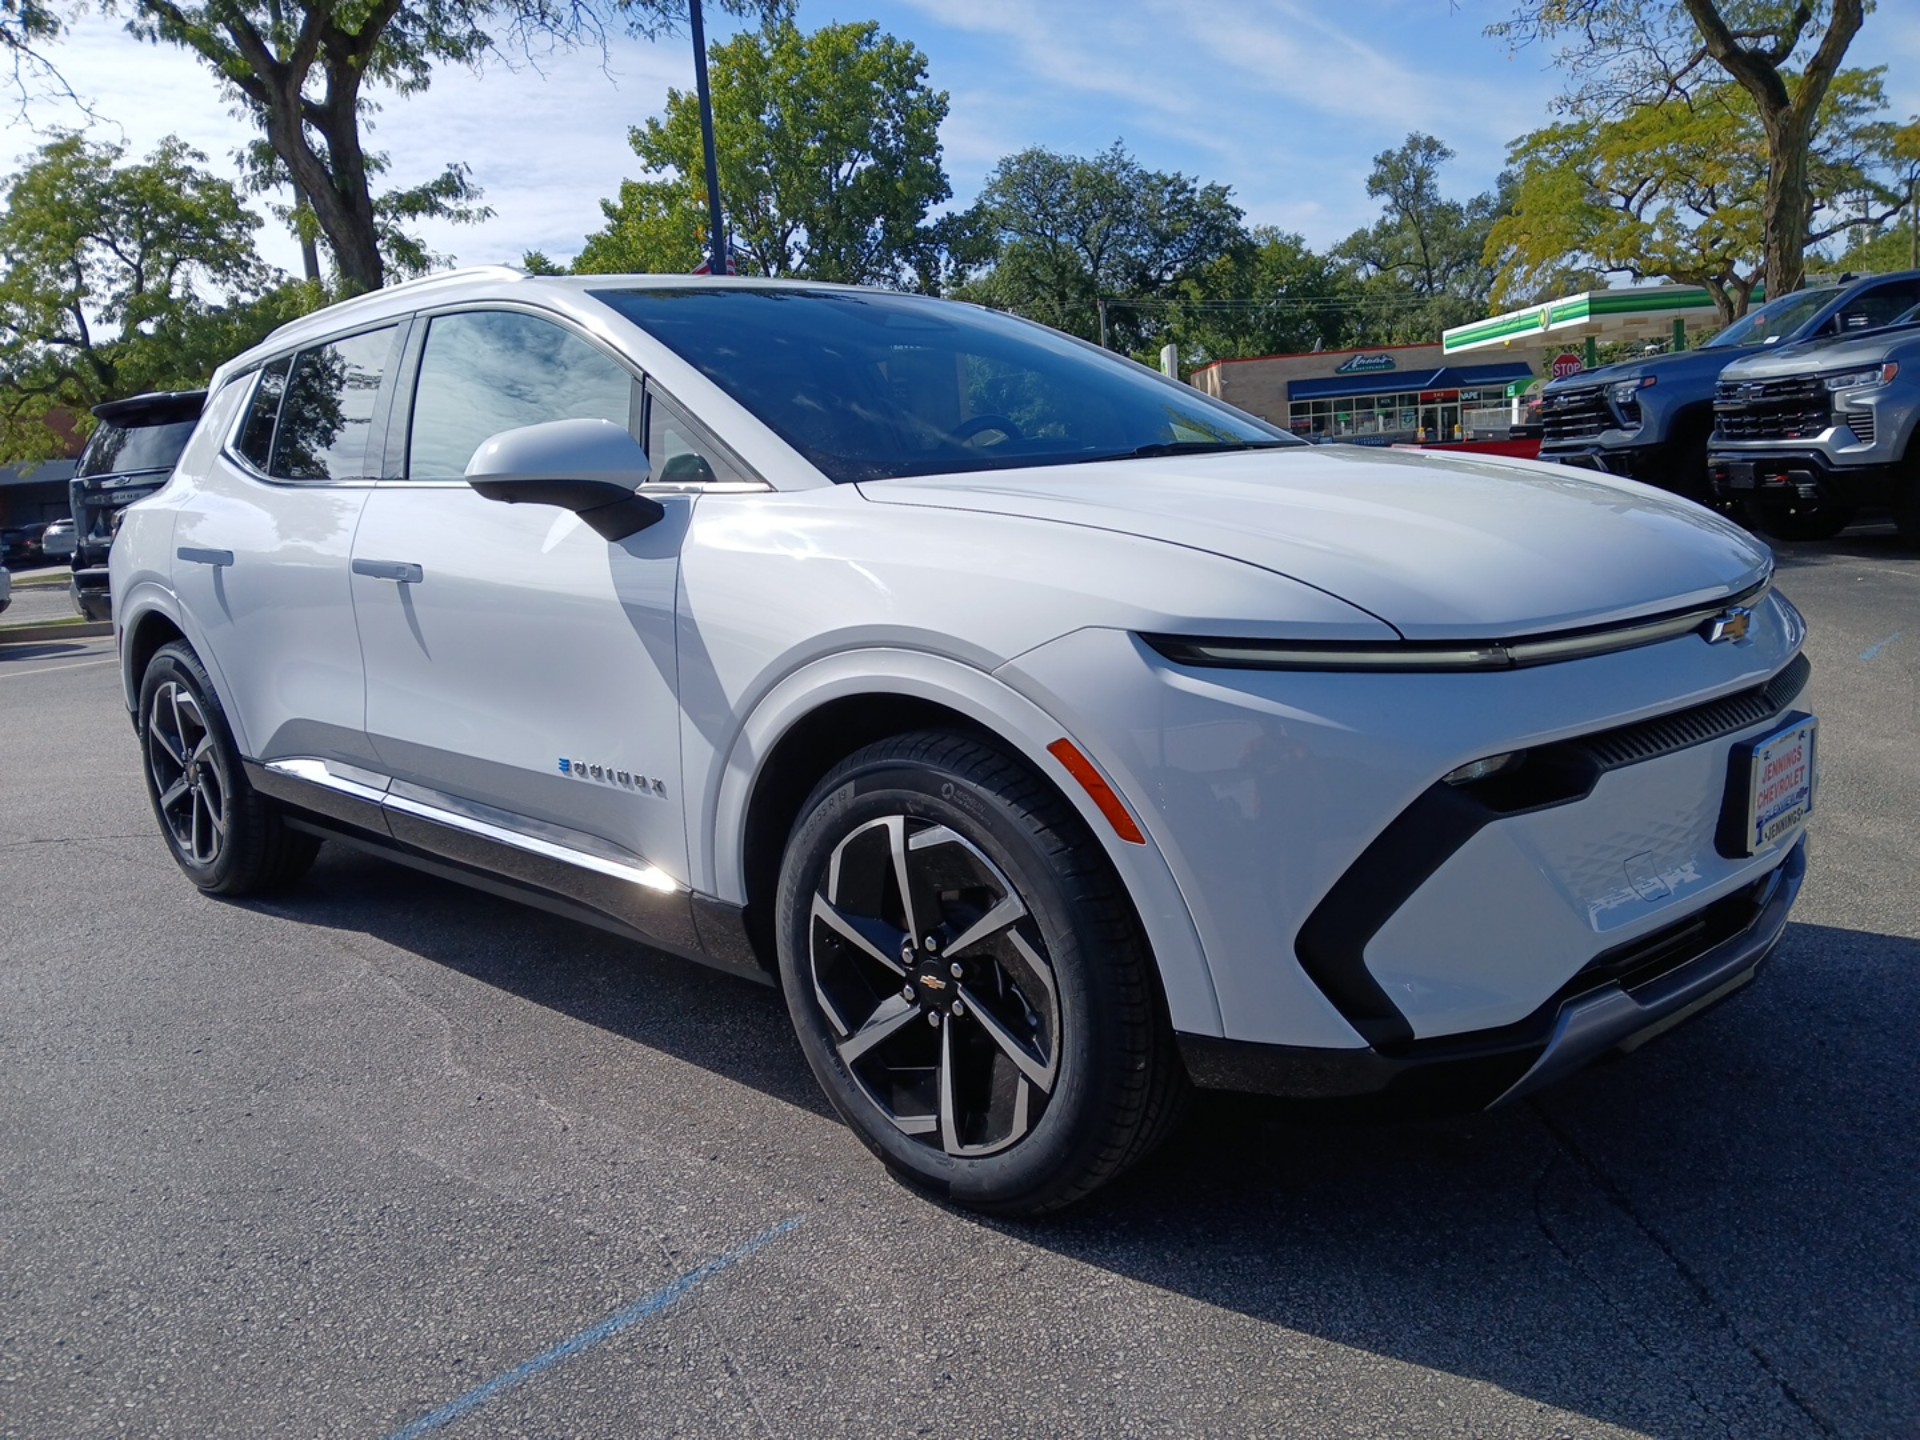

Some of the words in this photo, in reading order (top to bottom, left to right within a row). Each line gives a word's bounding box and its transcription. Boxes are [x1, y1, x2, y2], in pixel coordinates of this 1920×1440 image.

[1554, 362, 1581, 377] STOP
[1762, 746, 1804, 784] JENNINGS
[1757, 765, 1806, 810] CHEVROLET
[1766, 808, 1802, 841] JENNINGS
